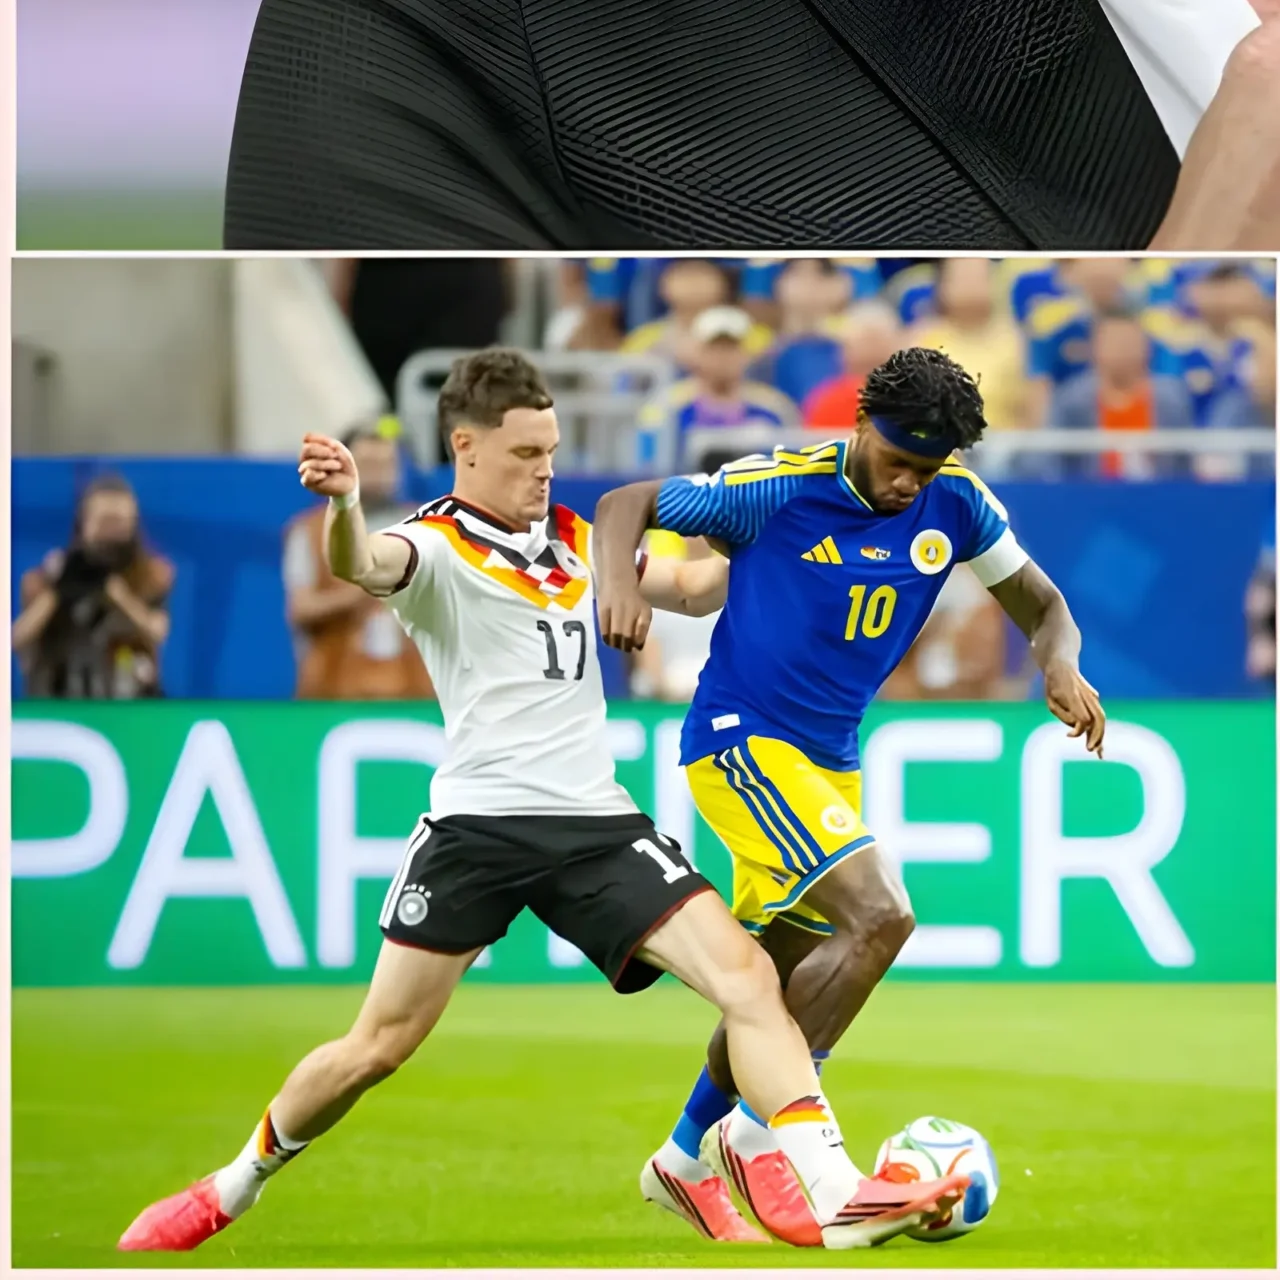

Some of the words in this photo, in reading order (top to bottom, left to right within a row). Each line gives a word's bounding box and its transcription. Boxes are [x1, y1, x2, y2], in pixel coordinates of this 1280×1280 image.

[844, 584, 898, 641] 10
[536, 620, 587, 681] 17
[11, 718, 1196, 969] PARER
